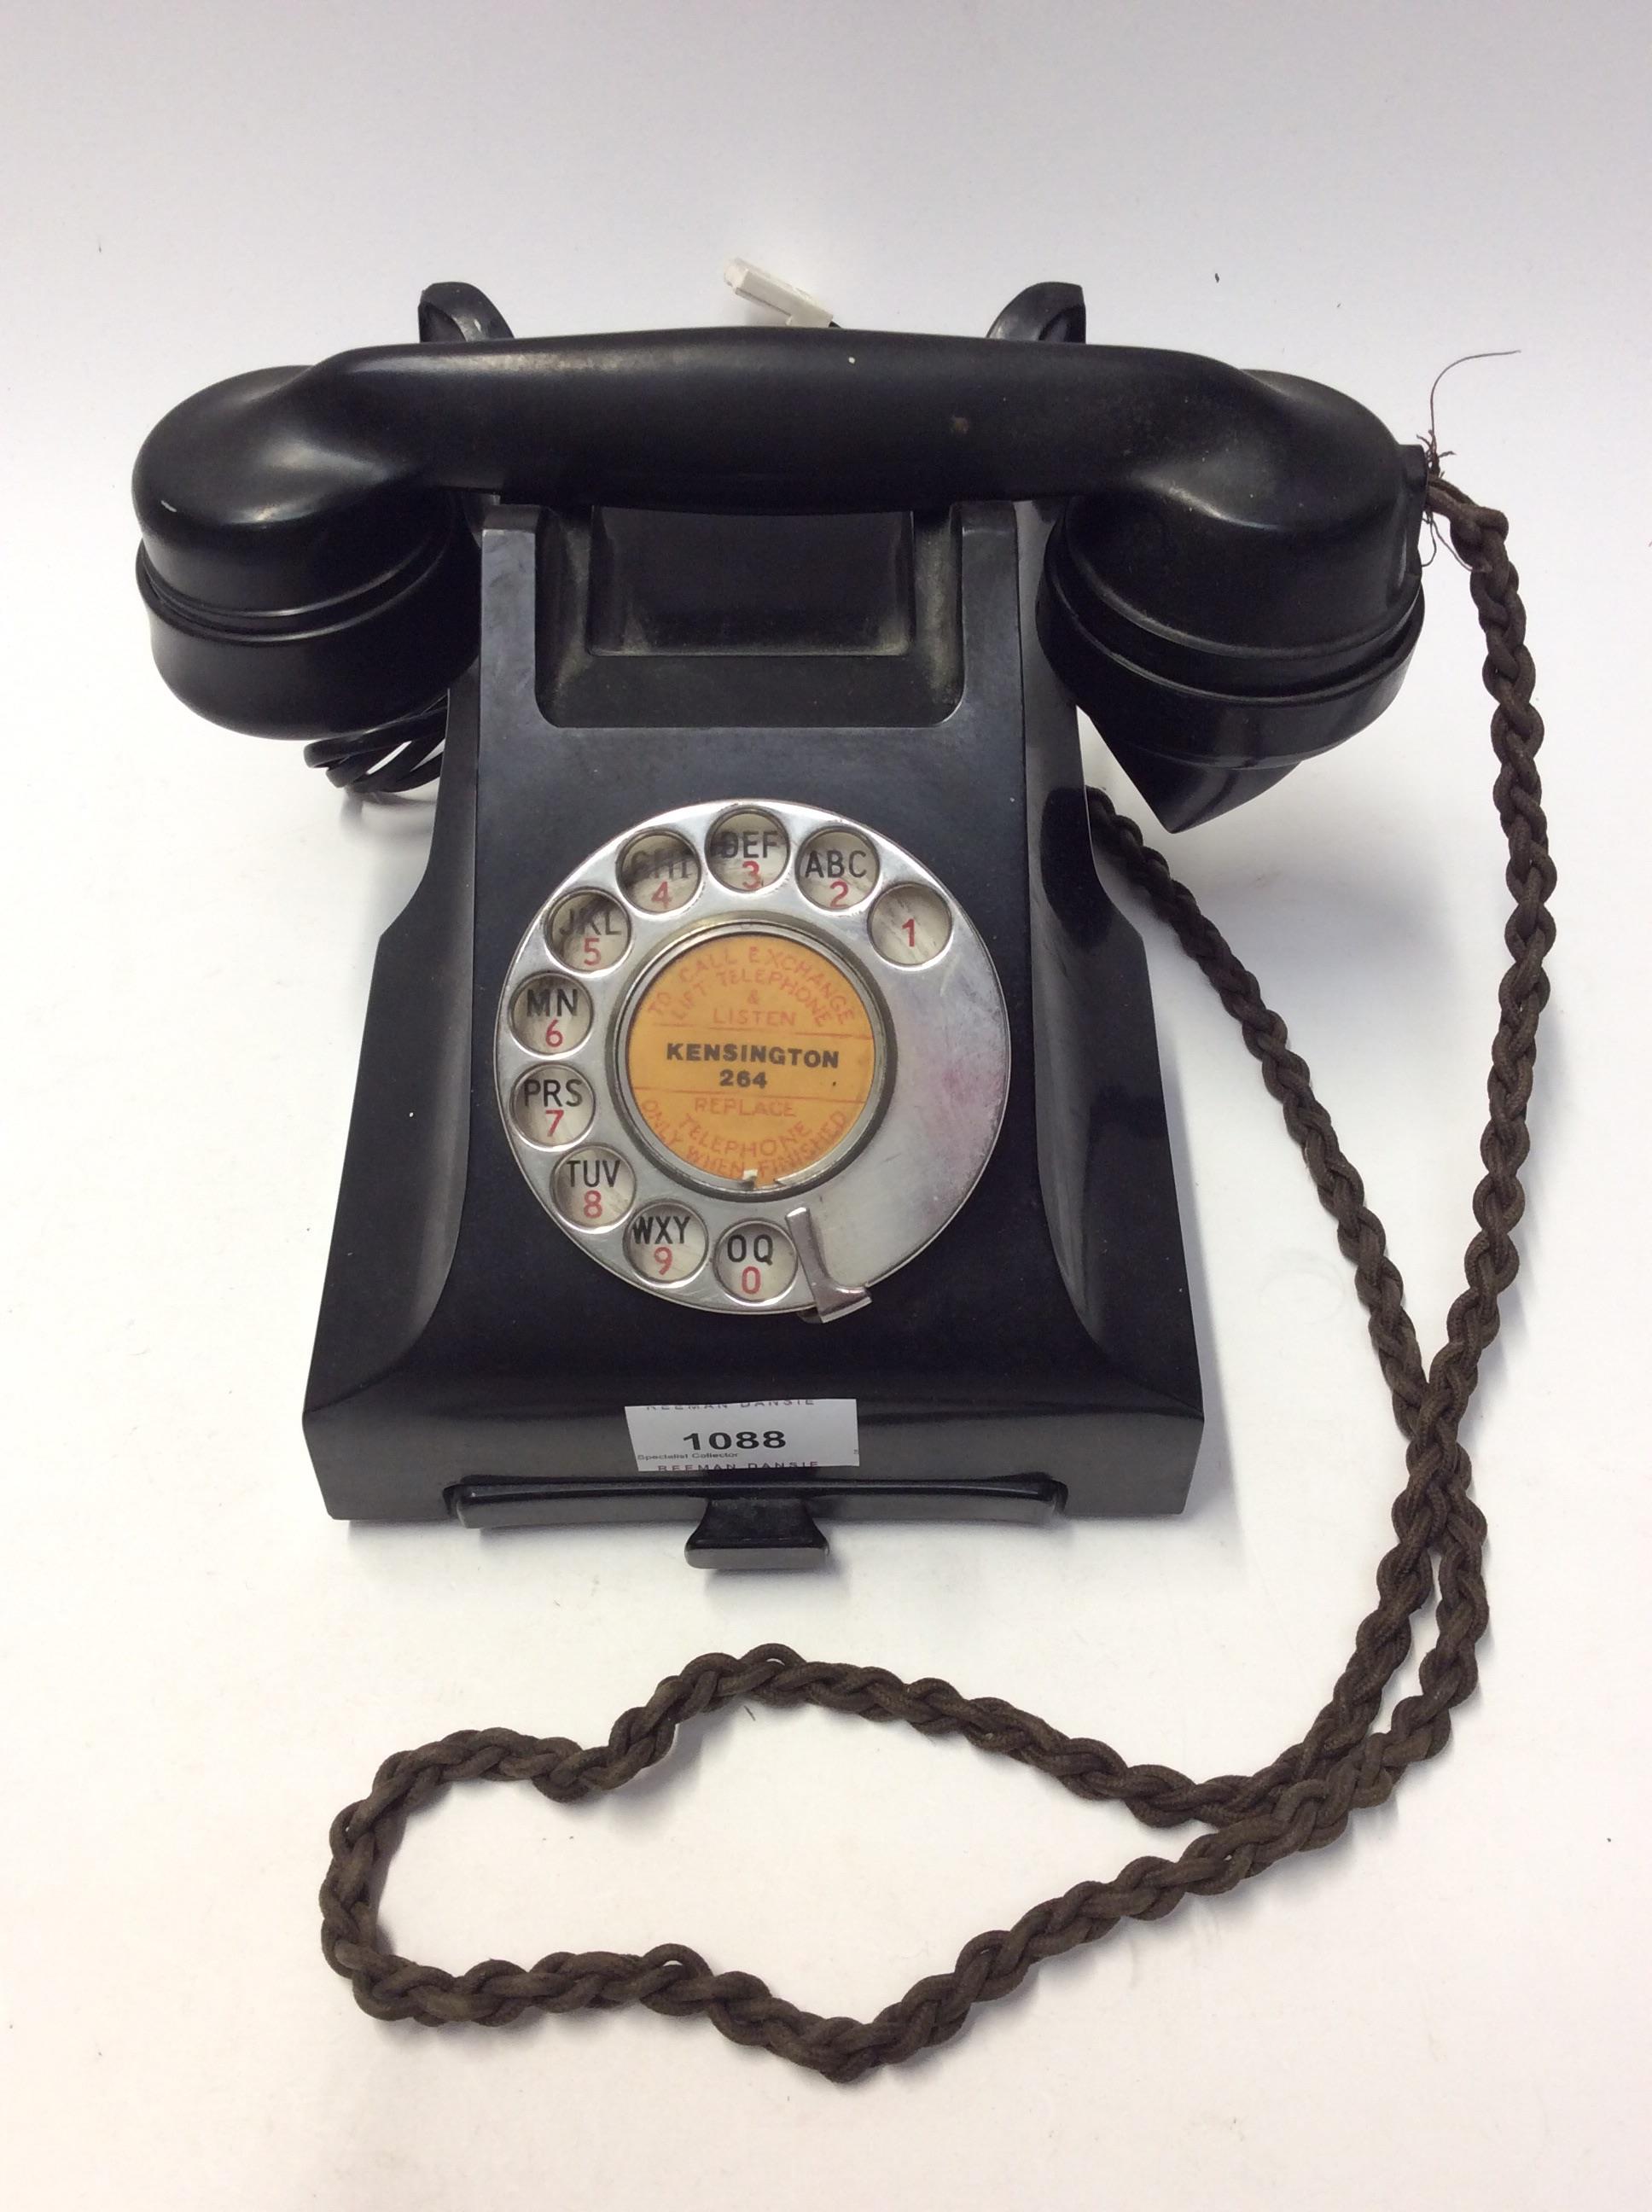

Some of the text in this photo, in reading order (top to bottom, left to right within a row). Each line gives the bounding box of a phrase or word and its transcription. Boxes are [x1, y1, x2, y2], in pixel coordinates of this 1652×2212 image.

[721, 830, 778, 859] DEF
[742, 860, 759, 888] 3
[805, 850, 867, 878] ABC
[651, 881, 672, 909] 4
[829, 880, 848, 907] 2
[559, 907, 621, 936] JKL
[902, 918, 915, 946] 1
[583, 937, 602, 965] 5
[679, 947, 737, 982] CALL
[748, 946, 853, 1024] EXCHANGE
[717, 968, 833, 1027] TELEPHONE
[747, 990, 759, 1005] &
[526, 988, 578, 1017] MN
[713, 1008, 797, 1025] LISTEN
[545, 1019, 563, 1048] 6
[666, 1043, 839, 1068] KENSINGTON
[719, 1069, 767, 1088] 264
[524, 1079, 583, 1107] PRS
[695, 1097, 797, 1117] REPLACE
[545, 1109, 564, 1137] 7
[680, 1113, 811, 1157] TELEPHONE
[642, 1100, 846, 1179] ONLY WHEN FINISHED
[567, 1160, 620, 1187] TUV
[584, 1190, 602, 1219] 8
[632, 1216, 690, 1244] WXY
[654, 1246, 672, 1274] 9
[727, 1234, 773, 1266] OQ
[742, 1266, 761, 1295] 0
[683, 1431, 786, 1450] 1088
